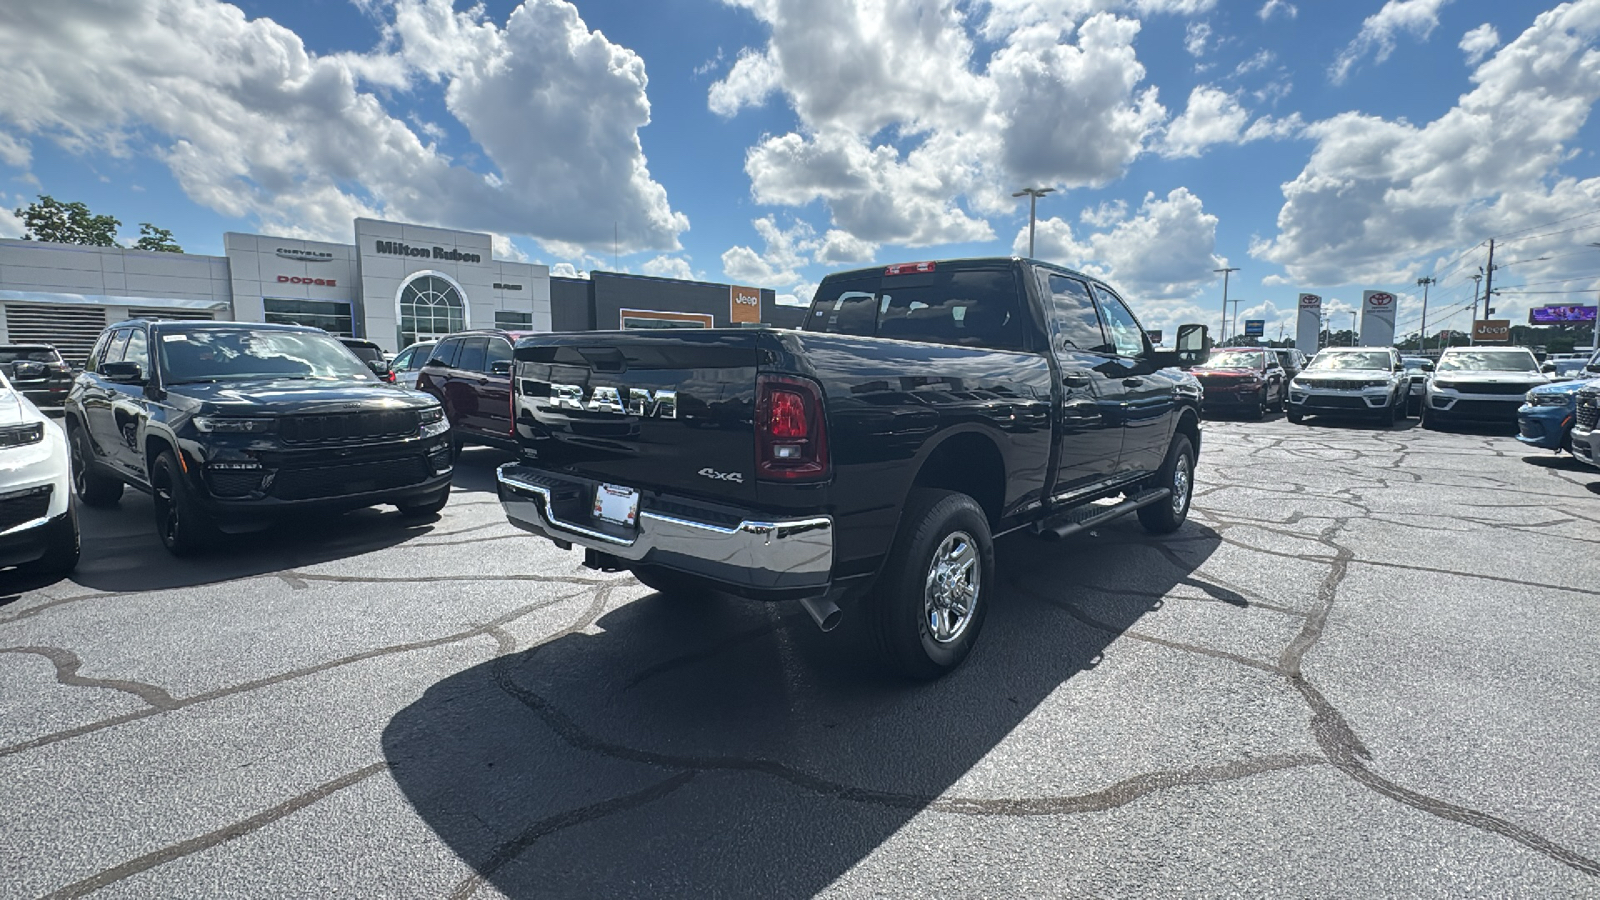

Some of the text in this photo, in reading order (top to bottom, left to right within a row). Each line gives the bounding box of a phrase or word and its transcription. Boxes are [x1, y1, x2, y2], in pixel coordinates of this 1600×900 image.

[276, 248, 333, 258] CHRYSLER
[376, 240, 481, 263] Milton Ruben
[277, 275, 337, 287] DODGE
[735, 292, 757, 306] Jeep
[1478, 325, 1507, 334] Jeep
[550, 383, 677, 419] RAM
